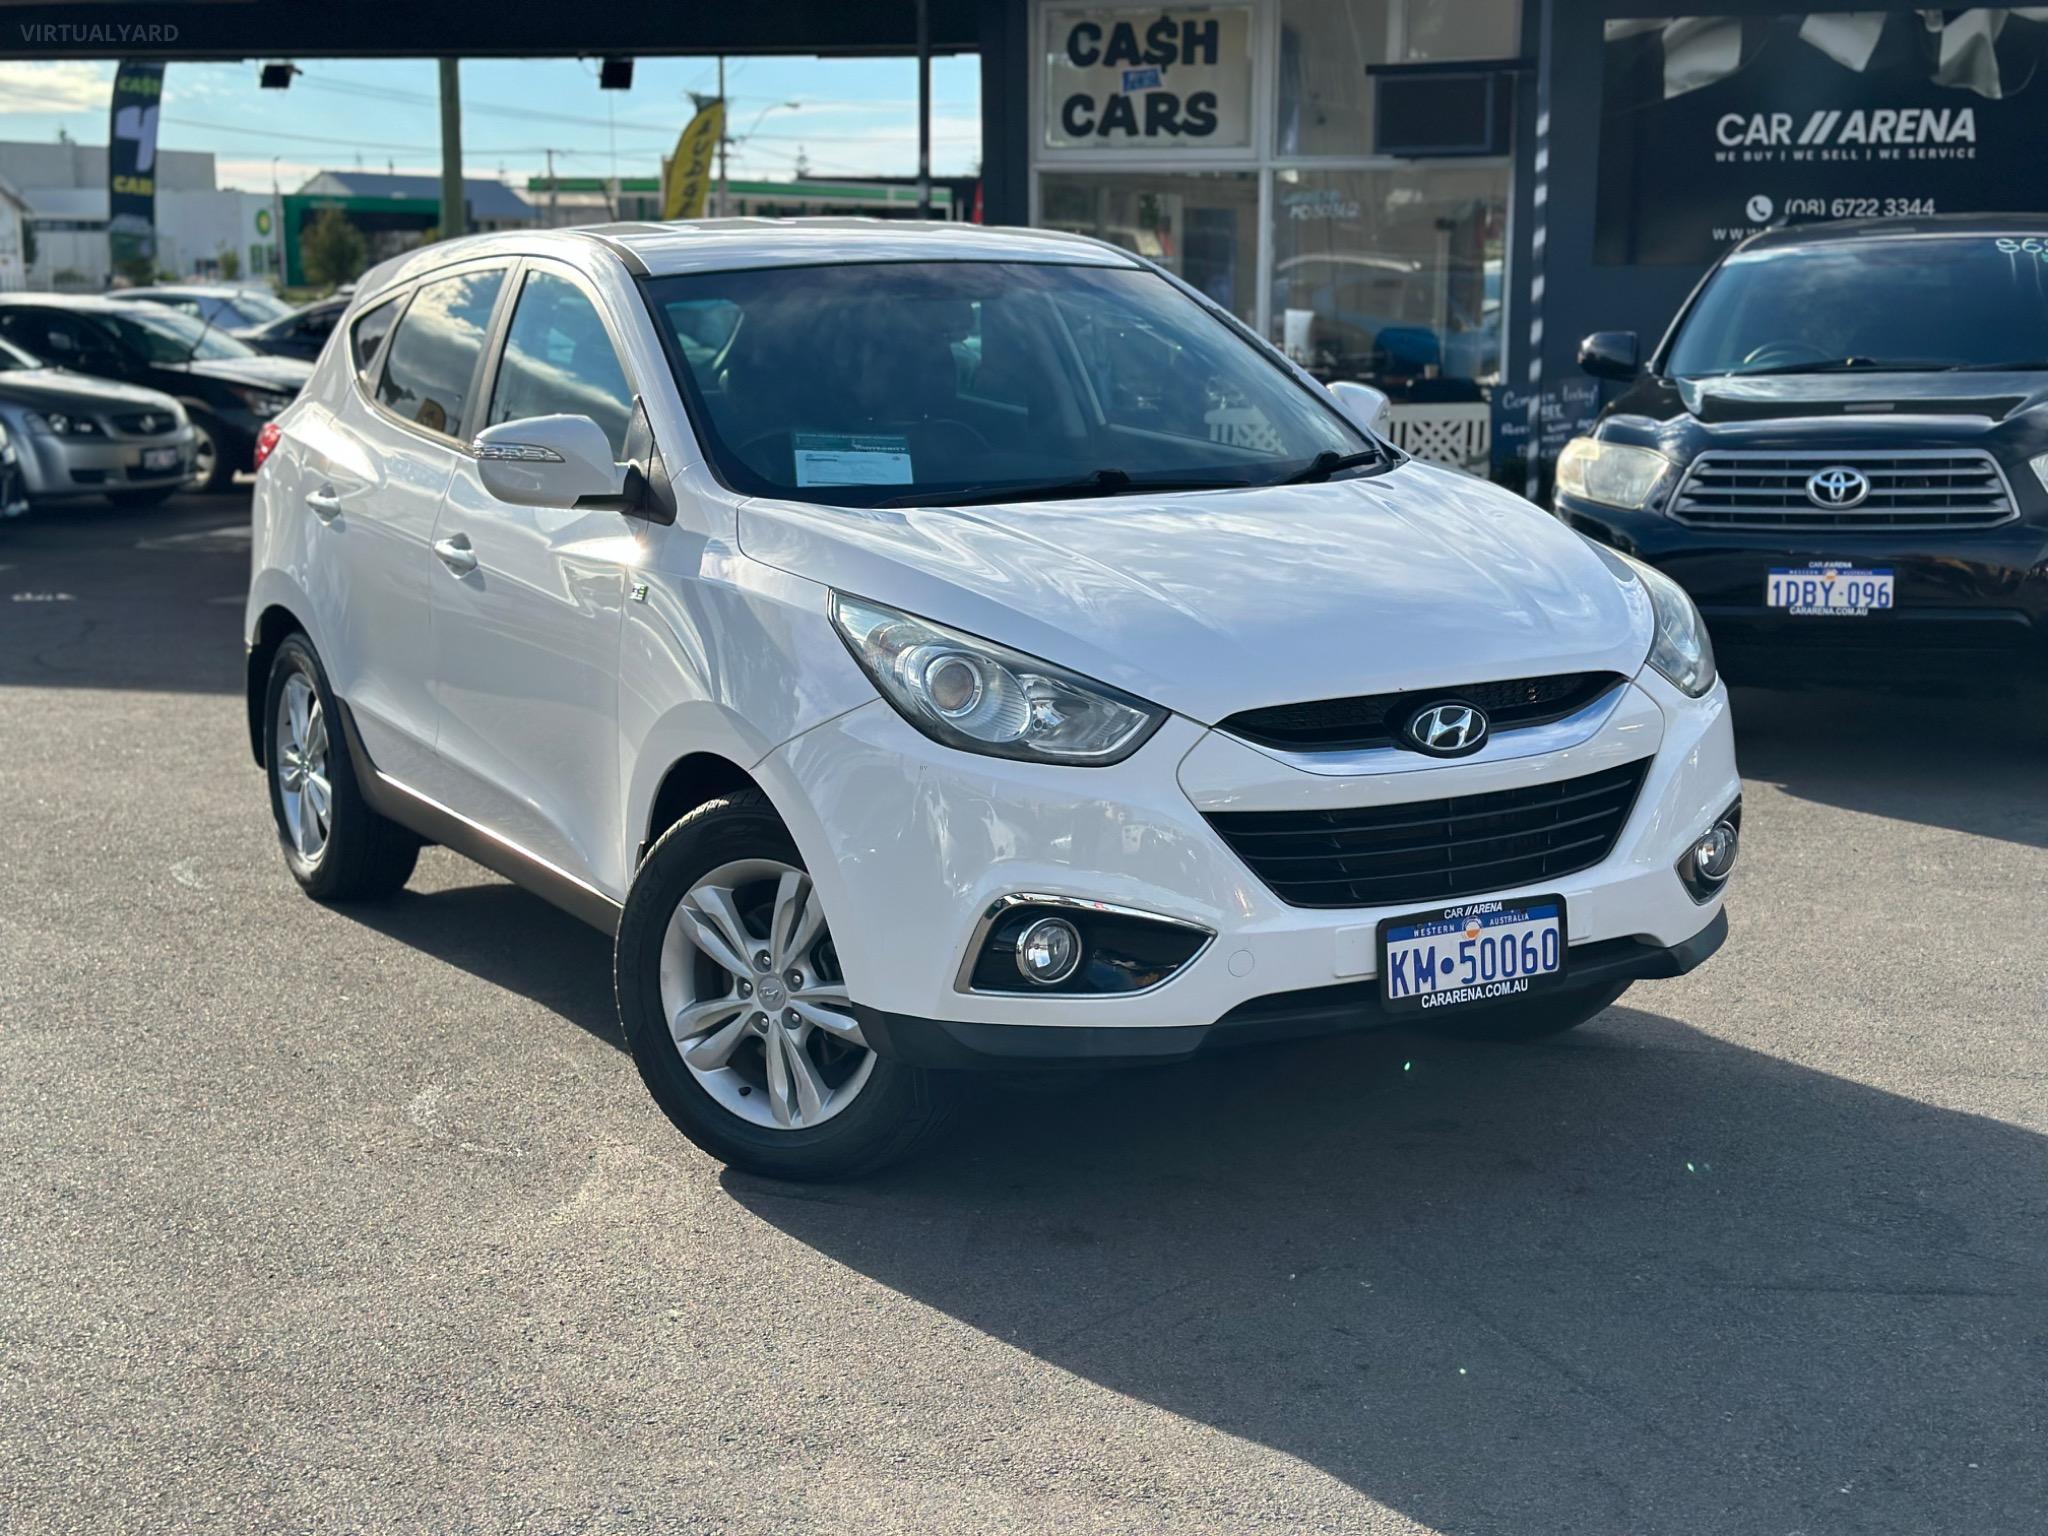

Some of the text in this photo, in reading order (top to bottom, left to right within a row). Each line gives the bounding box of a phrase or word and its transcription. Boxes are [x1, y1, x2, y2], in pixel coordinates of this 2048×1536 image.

[1062, 91, 1218, 138] CARS
[1716, 113, 1793, 147] CAR
[1715, 151, 1735, 162] WE
[1743, 151, 1773, 162] BUY
[1793, 150, 1814, 161] WE
[1821, 150, 1858, 161] SELL
[1878, 149, 1900, 160] WE
[1908, 148, 1976, 160] SERVICE
[1831, 198, 1879, 217] 6722
[1883, 198, 1935, 217] 3344
[1789, 606, 1868, 616] CARARENA.COM.AU
[1444, 907, 1463, 919] CAR
[1472, 902, 1503, 915] ARENA
[1413, 912, 1530, 937] WESTERN AUSTRALIA
[1421, 978, 1529, 1009] CARARENA.COM.AU
